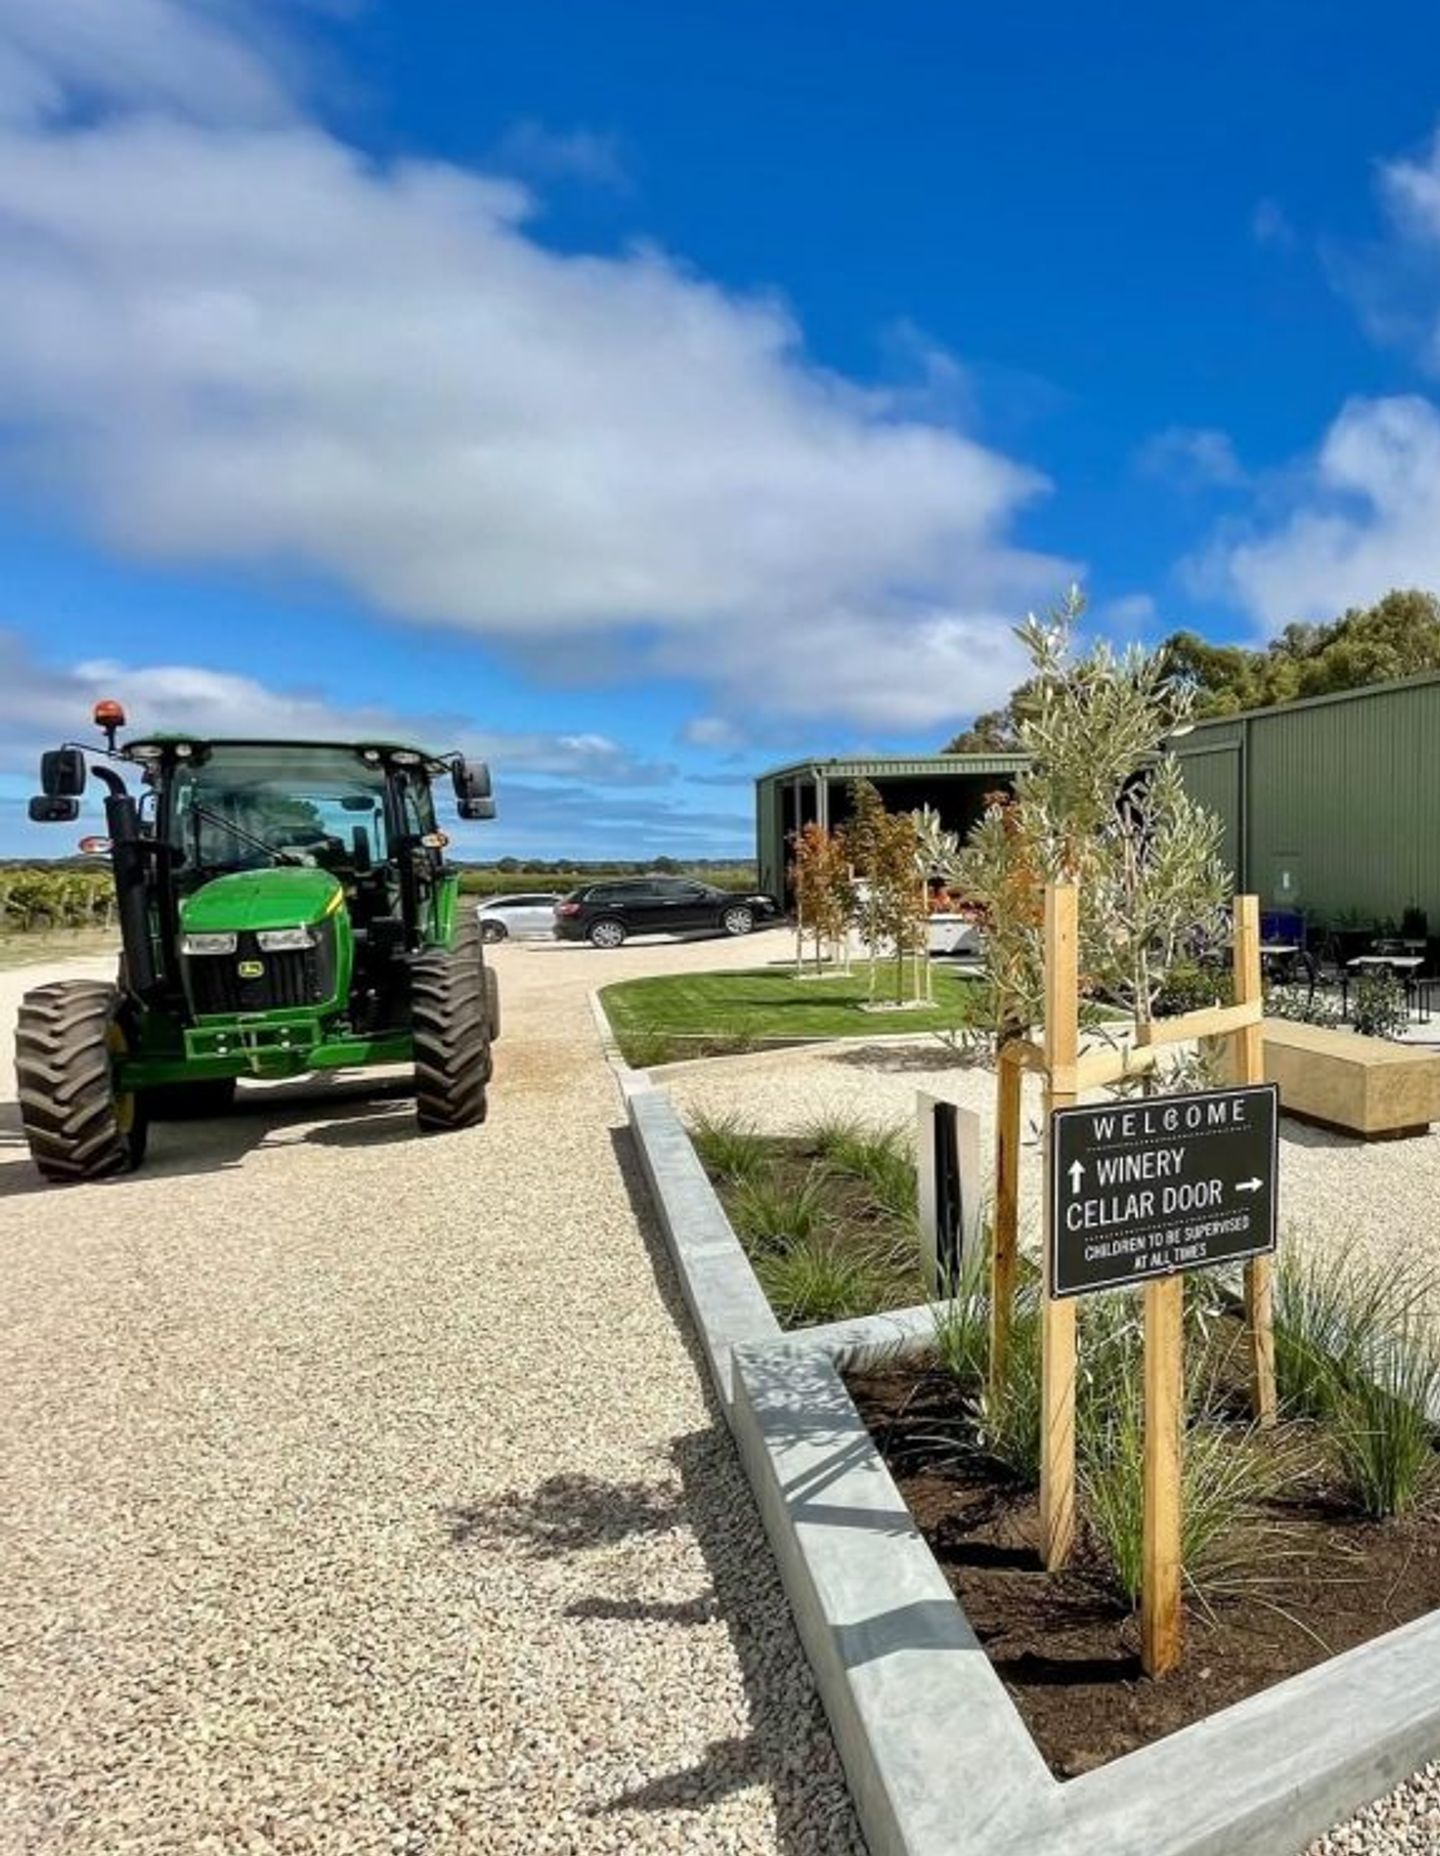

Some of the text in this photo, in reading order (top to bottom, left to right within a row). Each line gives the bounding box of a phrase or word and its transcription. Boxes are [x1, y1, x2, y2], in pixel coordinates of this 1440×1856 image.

[1093, 1099, 1246, 1140] WELCOME
[1096, 1148, 1186, 1187] WINERY
[1066, 1180, 1224, 1231] CELLAR DOOR
[1084, 1215, 1249, 1261] CHILDREN TO BE SUPERVISED
[1134, 1243, 1207, 1270] AT ALL TIMES
